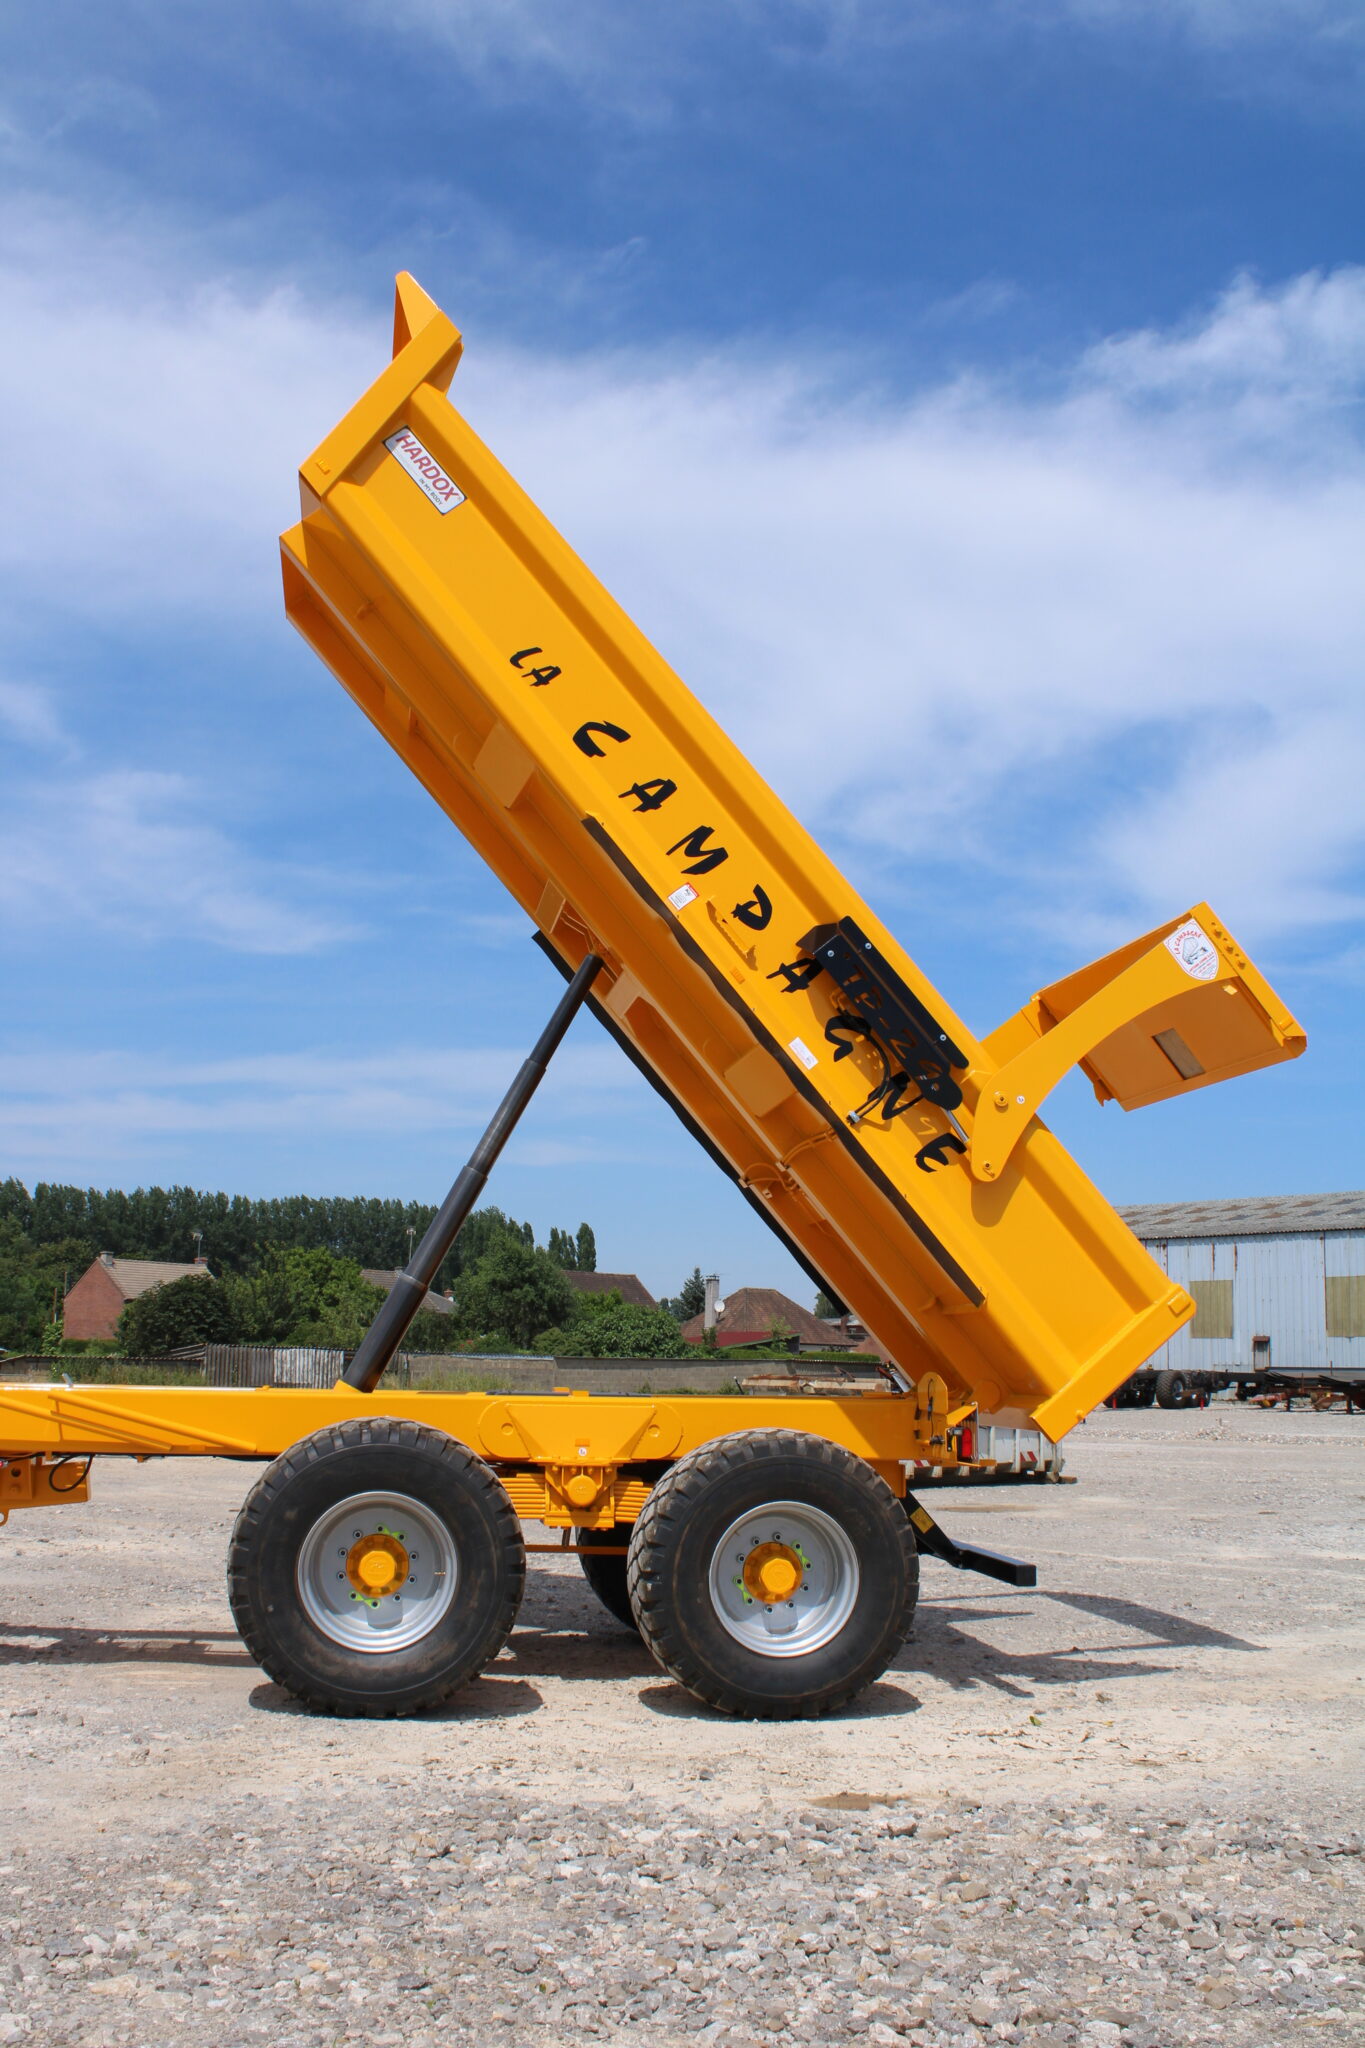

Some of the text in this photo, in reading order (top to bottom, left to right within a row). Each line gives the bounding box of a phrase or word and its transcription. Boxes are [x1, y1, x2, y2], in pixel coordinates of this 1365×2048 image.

[395, 434, 459, 502] HARDOX
[430, 491, 443, 505] BODY
[509, 646, 966, 1173] LA CAMPAGNE
